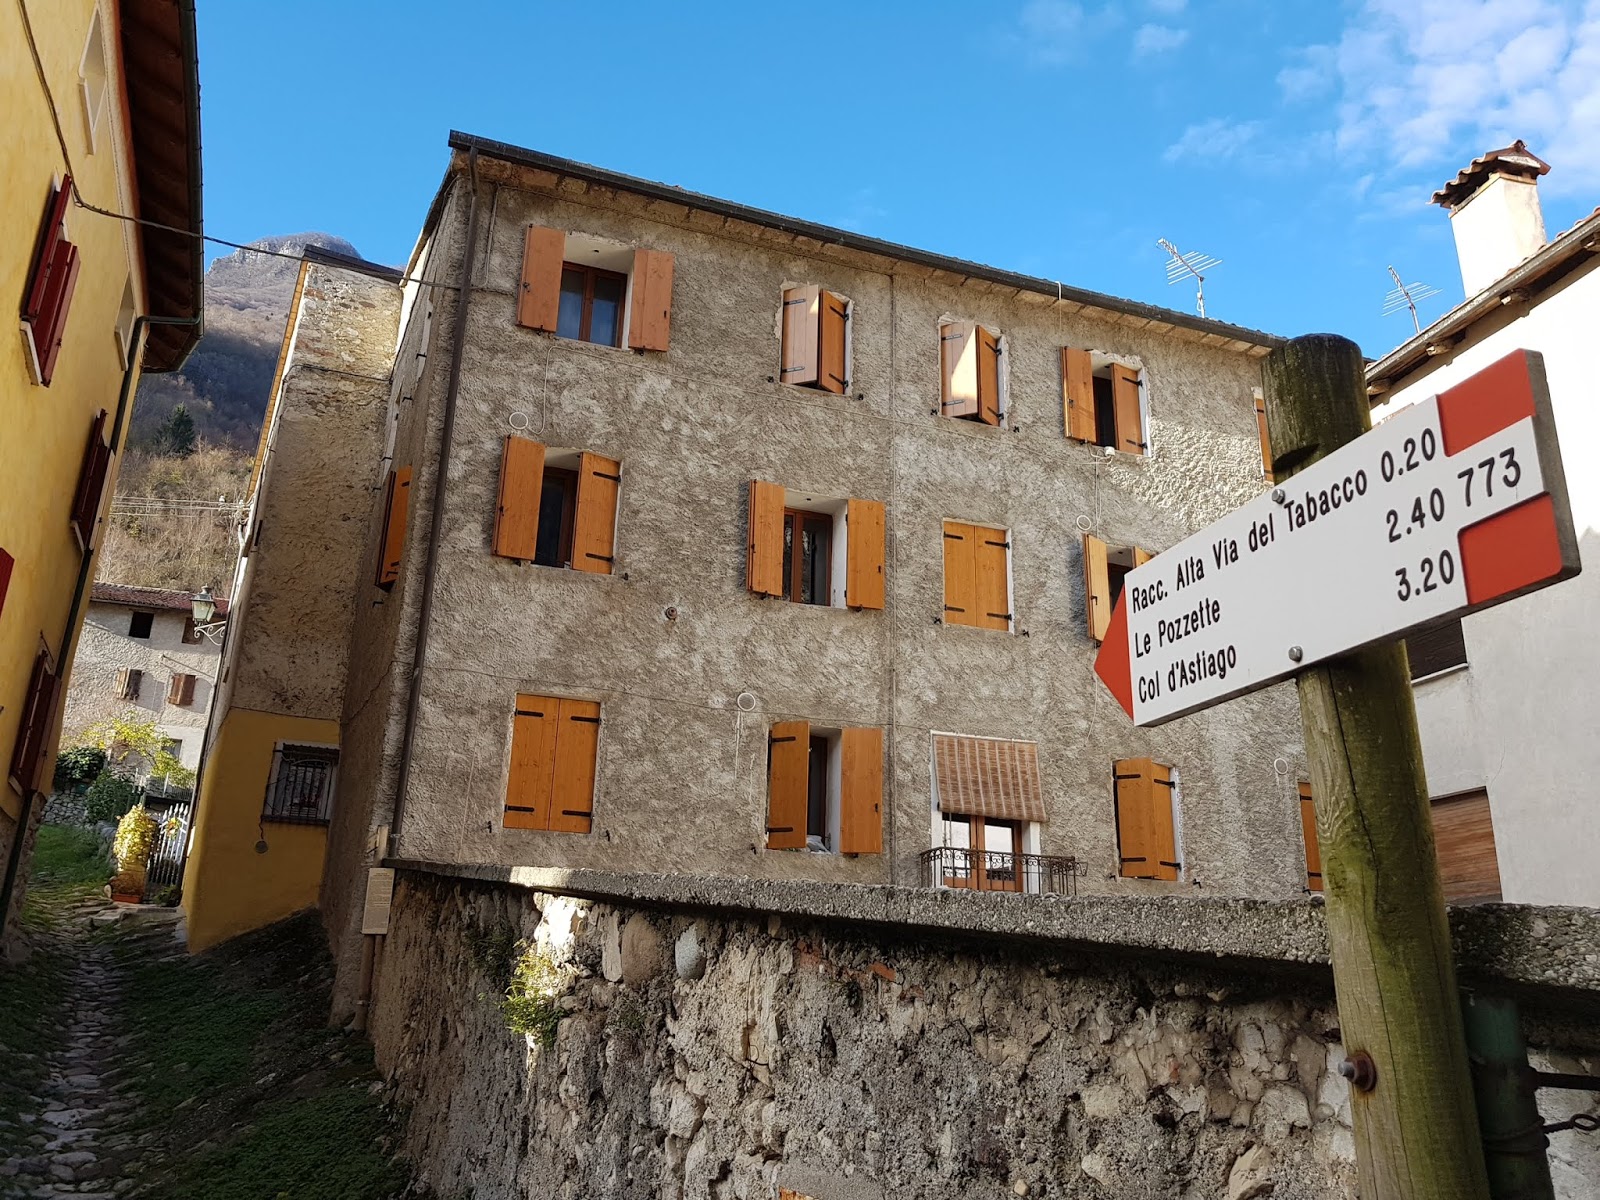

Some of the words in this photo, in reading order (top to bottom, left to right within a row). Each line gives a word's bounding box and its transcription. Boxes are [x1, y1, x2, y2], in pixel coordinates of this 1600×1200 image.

[1132, 579, 1169, 614] Racc.
[1176, 556, 1205, 592] Alta
[1212, 538, 1239, 570] Via
[1248, 512, 1275, 553] del
[1283, 469, 1368, 532] Tabacco
[1380, 427, 1436, 483] 0.20
[1457, 446, 1521, 508] 773
[1134, 632, 1151, 659] Le
[1158, 597, 1221, 648] Pozzette
[1386, 487, 1445, 543] 2.40
[1138, 670, 1160, 704] Col
[1167, 644, 1237, 693] d'Astiago
[1395, 549, 1455, 602] 3.20
